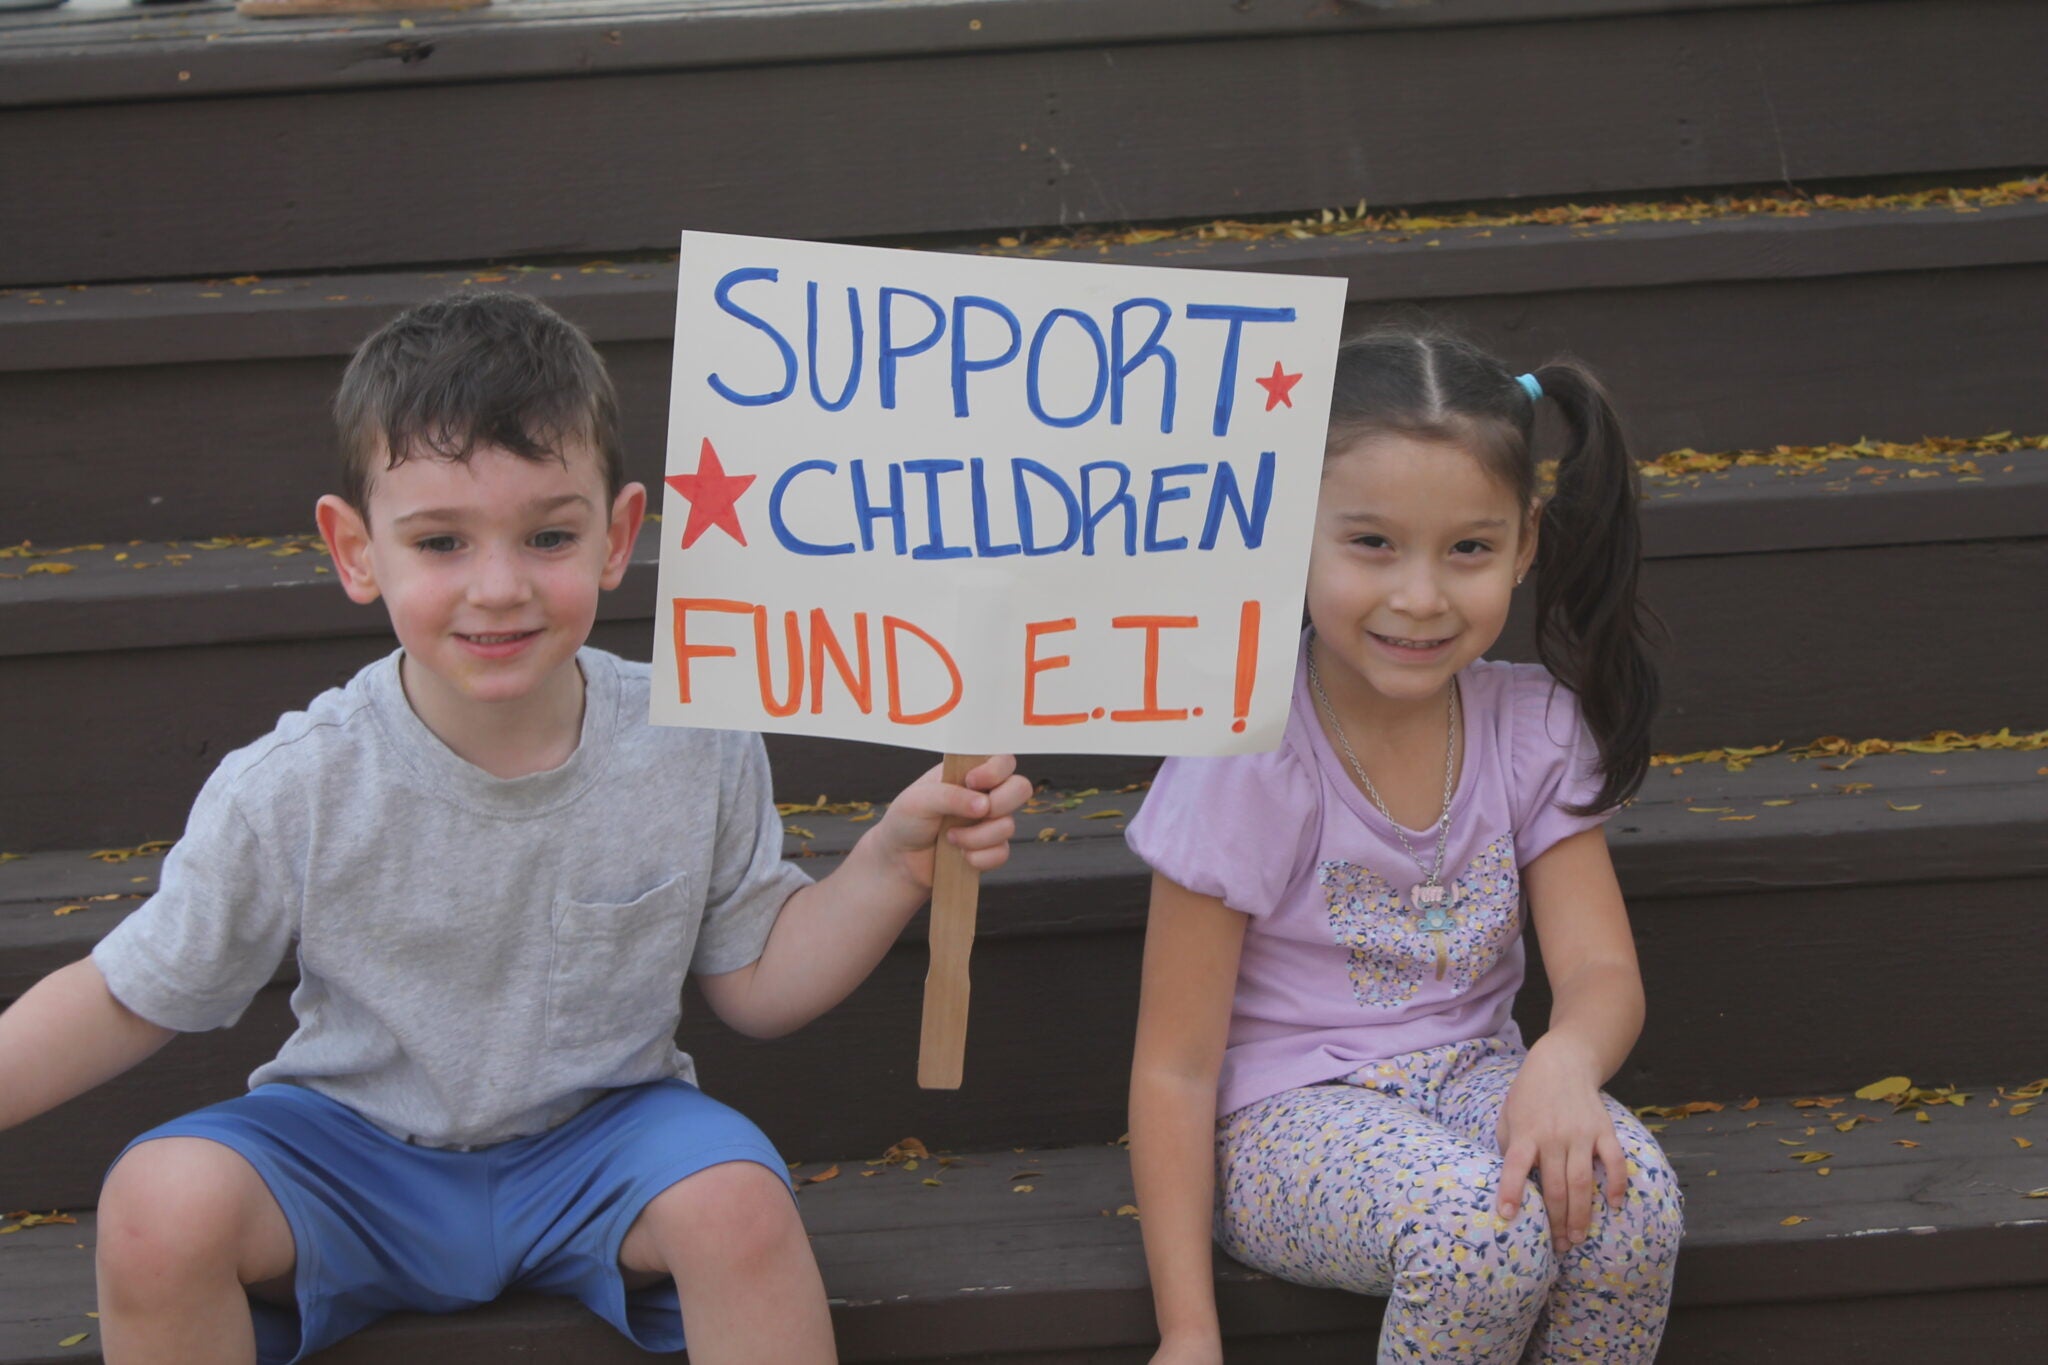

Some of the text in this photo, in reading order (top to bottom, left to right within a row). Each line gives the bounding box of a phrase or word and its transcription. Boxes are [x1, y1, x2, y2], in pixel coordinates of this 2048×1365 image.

[707, 267, 1297, 437] SUPPORT
[768, 451, 1277, 560] CHILDREN
[672, 597, 964, 726] FUND
